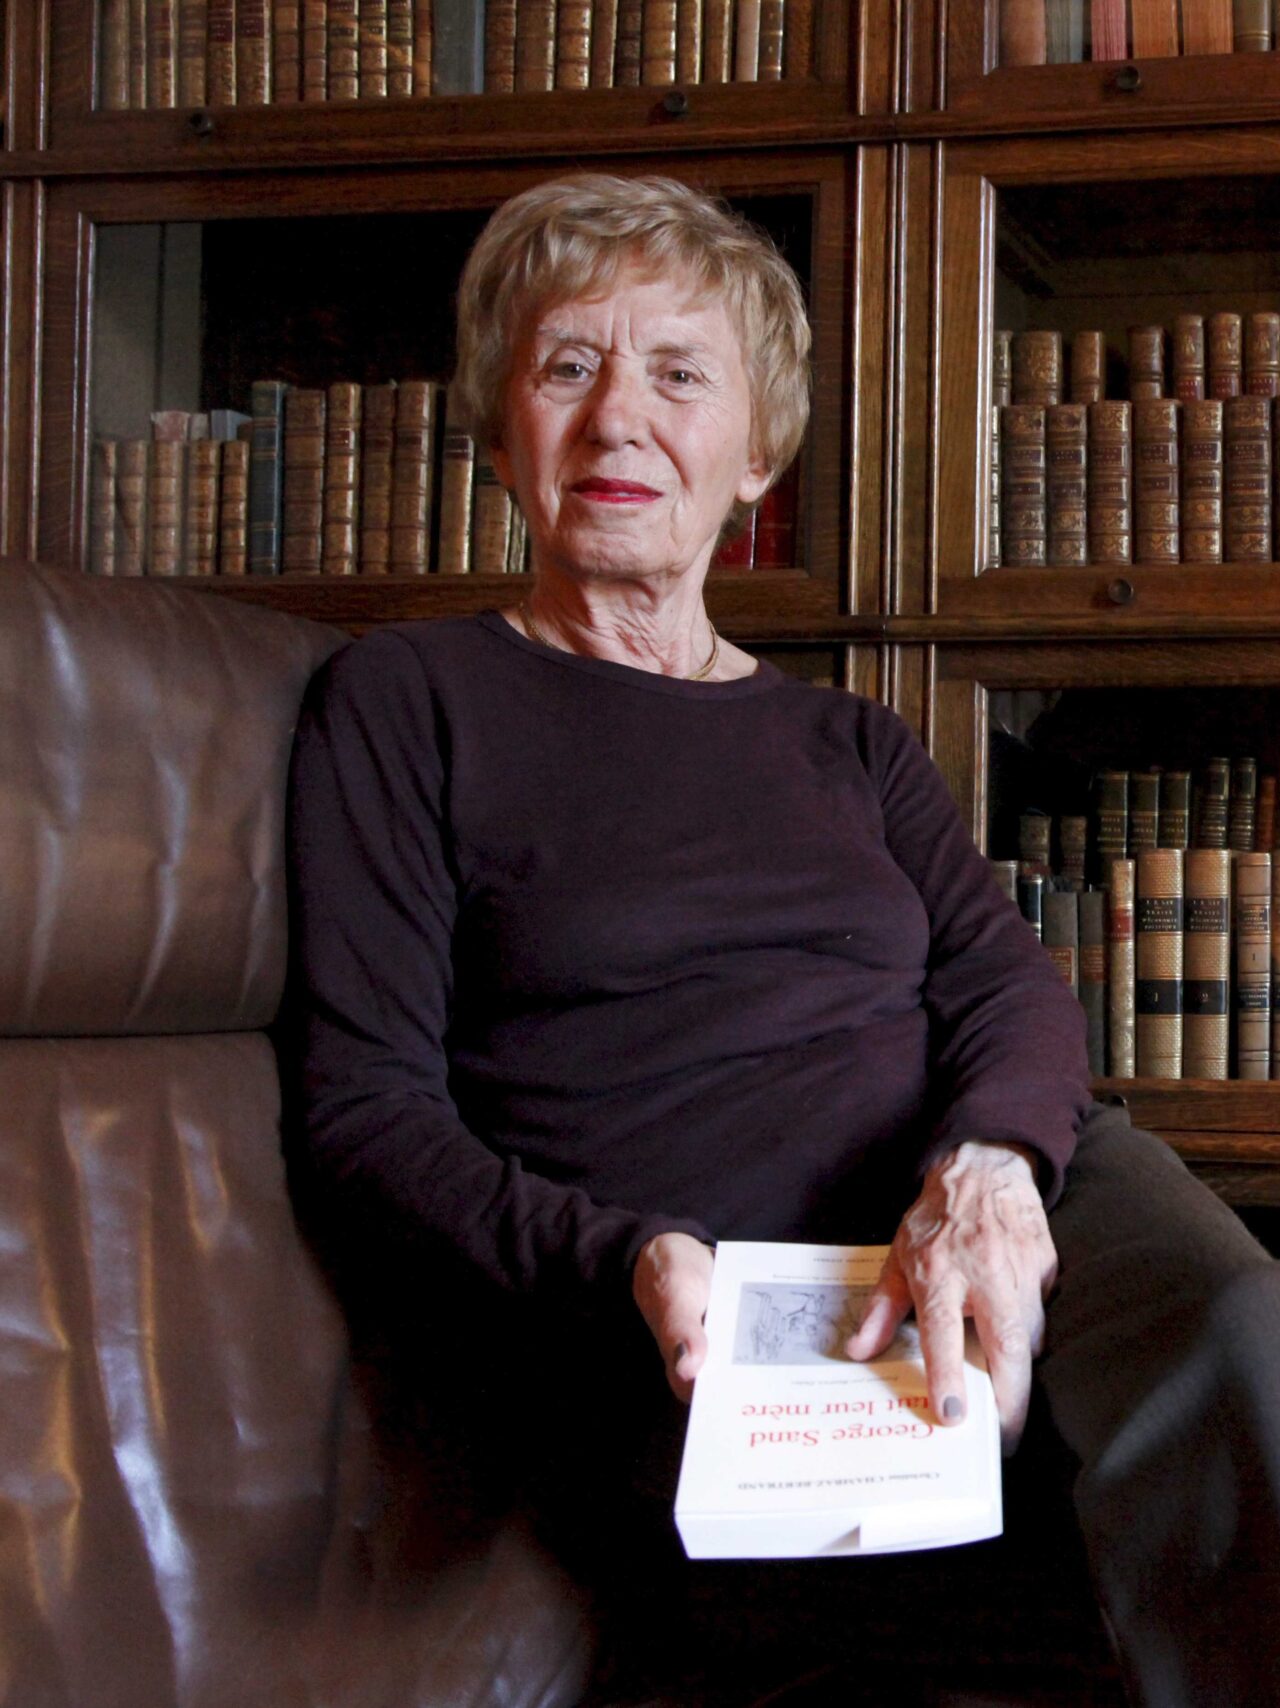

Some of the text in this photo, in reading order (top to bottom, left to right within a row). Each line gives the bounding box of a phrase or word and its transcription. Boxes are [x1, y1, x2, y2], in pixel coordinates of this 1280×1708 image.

[742, 1395, 929, 1420] tait leur mère
[749, 1423, 934, 1448] George Sand
